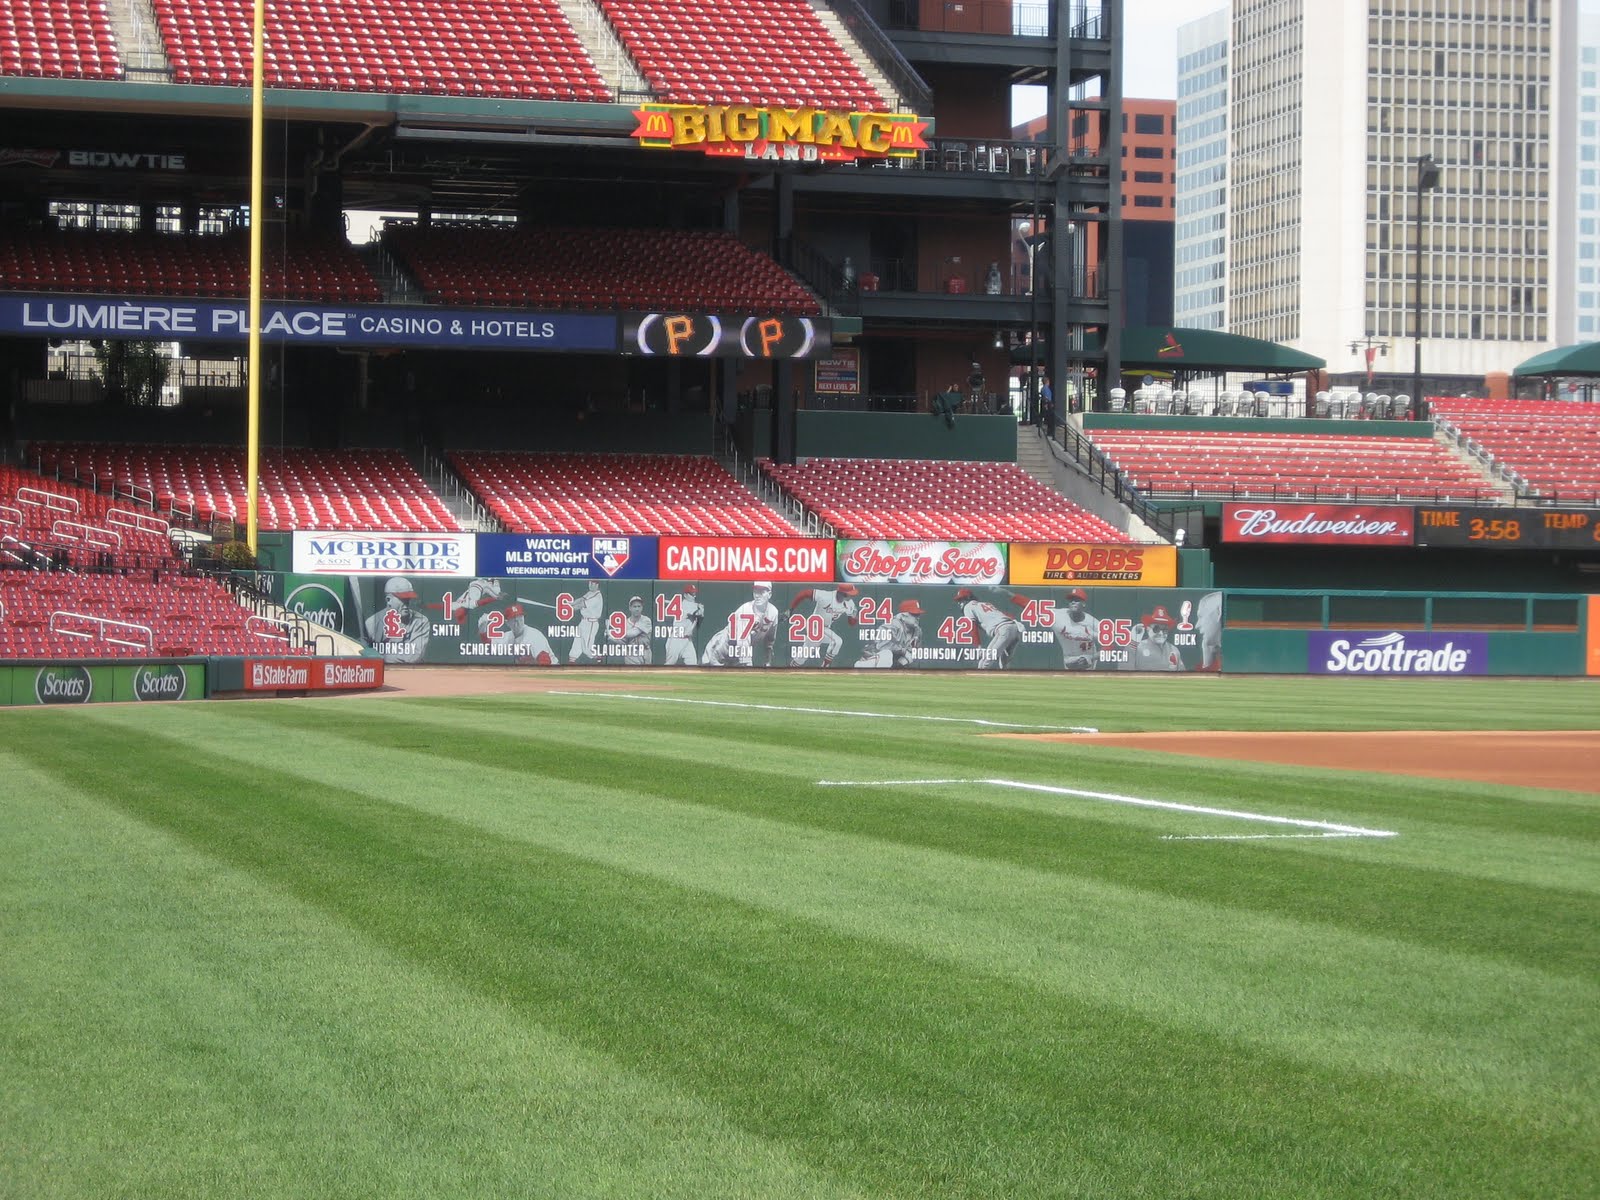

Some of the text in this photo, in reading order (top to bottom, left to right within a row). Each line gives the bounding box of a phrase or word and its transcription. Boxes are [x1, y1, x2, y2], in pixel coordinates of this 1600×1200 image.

[670, 104, 893, 152] BIG MAC
[69, 151, 185, 169] BOWTIE
[744, 143, 818, 161] LAND
[23, 302, 197, 332] LUMIÈRE
[212, 309, 347, 336] PLACE
[360, 317, 443, 334] CASINO
[450, 320, 463, 335] &
[471, 320, 555, 337] HOTELS
[664, 315, 696, 355] P
[758, 318, 784, 357] P
[1233, 509, 1397, 536] Budweiser
[1420, 511, 1461, 527] TIME
[1468, 518, 1521, 541] 3:58
[1543, 513, 1588, 529] TEMP
[526, 538, 570, 550] WATCH
[595, 540, 627, 550] MLB
[361, 558, 459, 570] HOMES
[506, 551, 588, 563] MLB TONIGHT
[666, 545, 827, 573] CARDINALS.COM
[934, 547, 999, 577] Save
[1045, 548, 1145, 571] DOBBS
[506, 567, 589, 576] WEEKNIGHTS AT 5PM
[1101, 572, 1139, 580] CENTERS
[442, 591, 452, 620] 1
[556, 593, 574, 621] 6
[655, 593, 682, 622] 14
[859, 597, 893, 625] 24
[1020, 600, 1056, 628] 45
[432, 624, 460, 637] SMITH
[486, 611, 505, 638] 2
[548, 626, 581, 637] MUSIAL
[609, 611, 627, 640] 9
[655, 626, 684, 638] BOYER
[728, 613, 755, 641] 17
[788, 614, 824, 642] 20
[859, 629, 892, 640] HERZOG
[937, 616, 974, 644] 42
[1098, 619, 1132, 647] 85
[372, 642, 416, 655] HORNSBY
[1022, 631, 1054, 643] GIBSON
[1174, 633, 1196, 645] BUCK
[460, 643, 531, 656] SCHOENDIENST
[591, 644, 644, 657] SLAUGHTER
[728, 646, 753, 657] DEAN
[791, 646, 820, 658] BROCK
[1100, 651, 1128, 662] BUSCH
[1327, 637, 1467, 672] Scottrade
[44, 673, 85, 696] Scotts
[141, 670, 179, 693] Scotts
